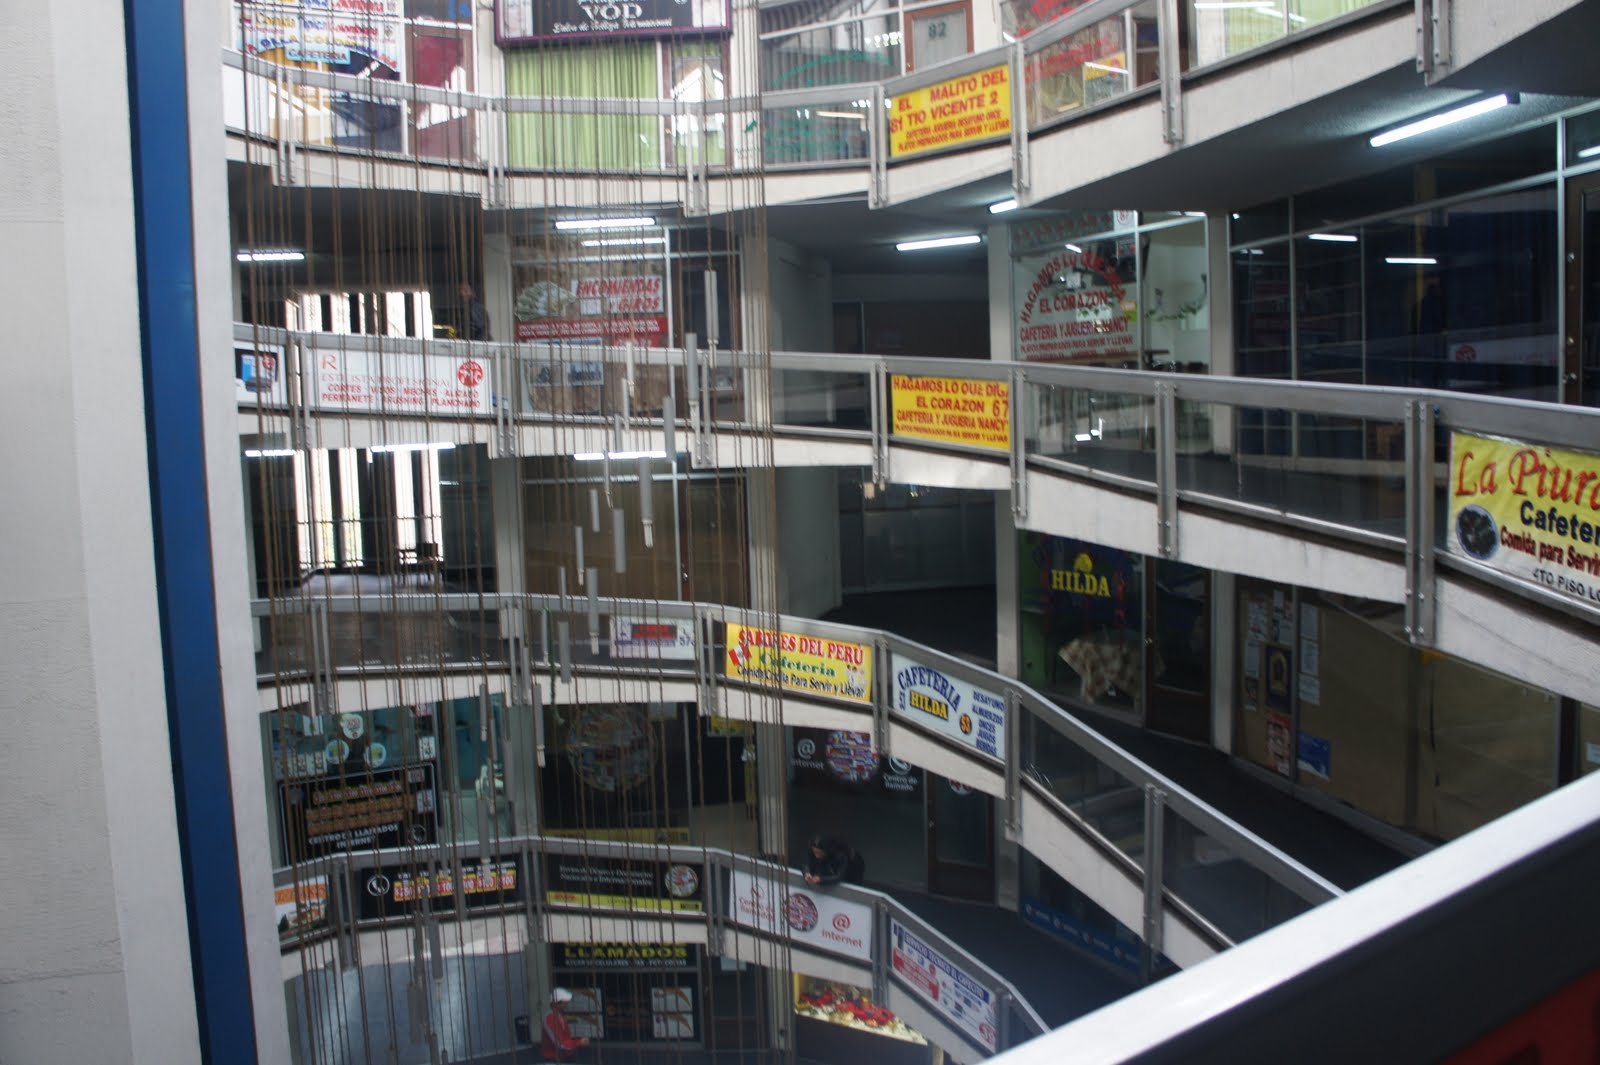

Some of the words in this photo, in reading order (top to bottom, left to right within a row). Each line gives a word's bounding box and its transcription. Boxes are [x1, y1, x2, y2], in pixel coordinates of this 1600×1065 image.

[288, 50, 347, 61] CAFETERIA
[898, 97, 912, 111] EL
[981, 69, 1007, 88] DEL
[907, 110, 926, 126] TIO
[930, 94, 985, 120] VICENTE
[990, 91, 999, 105] 2
[575, 277, 661, 298] ENCOMIENDAS
[1020, 256, 1061, 323] HAGAMOS
[1062, 254, 1077, 267] LO
[619, 297, 660, 310] GIROS
[1039, 298, 1052, 314] EL
[1054, 290, 1108, 311] CORAZON
[1020, 324, 1057, 341] CAFETERIA
[322, 354, 337, 370] R
[328, 384, 362, 393] CORTES
[894, 375, 943, 393] HAGAMOS
[945, 381, 959, 394] LO
[961, 382, 984, 396] QUE
[896, 410, 934, 424] CAFETERIA
[935, 413, 941, 424] Y
[916, 396, 928, 408] EL
[931, 397, 985, 413] CORAZON
[992, 400, 1009, 418] 67
[1455, 451, 1498, 496] La
[1501, 524, 1537, 556] Comida
[1539, 541, 1564, 563] para
[1051, 569, 1111, 598] HILDA
[1558, 574, 1586, 596] PISO
[738, 628, 797, 652] SABORES
[799, 637, 825, 657] DEL
[827, 640, 864, 666] PERÚ
[737, 665, 763, 679] Comida
[791, 672, 808, 687] Para
[809, 677, 832, 693] Servir
[833, 684, 839, 696] y
[840, 683, 865, 698] Llevar
[898, 666, 961, 712] CAFETERIA
[910, 691, 949, 720] HILDA
[791, 759, 824, 770] internet
[354, 823, 399, 837] LLAMADOS
[822, 929, 863, 948] internet
[565, 946, 687, 958] LLAMADOS
[905, 933, 928, 958] SERVICIO
[951, 965, 958, 980] EL
[959, 971, 984, 999] CAFECITO
